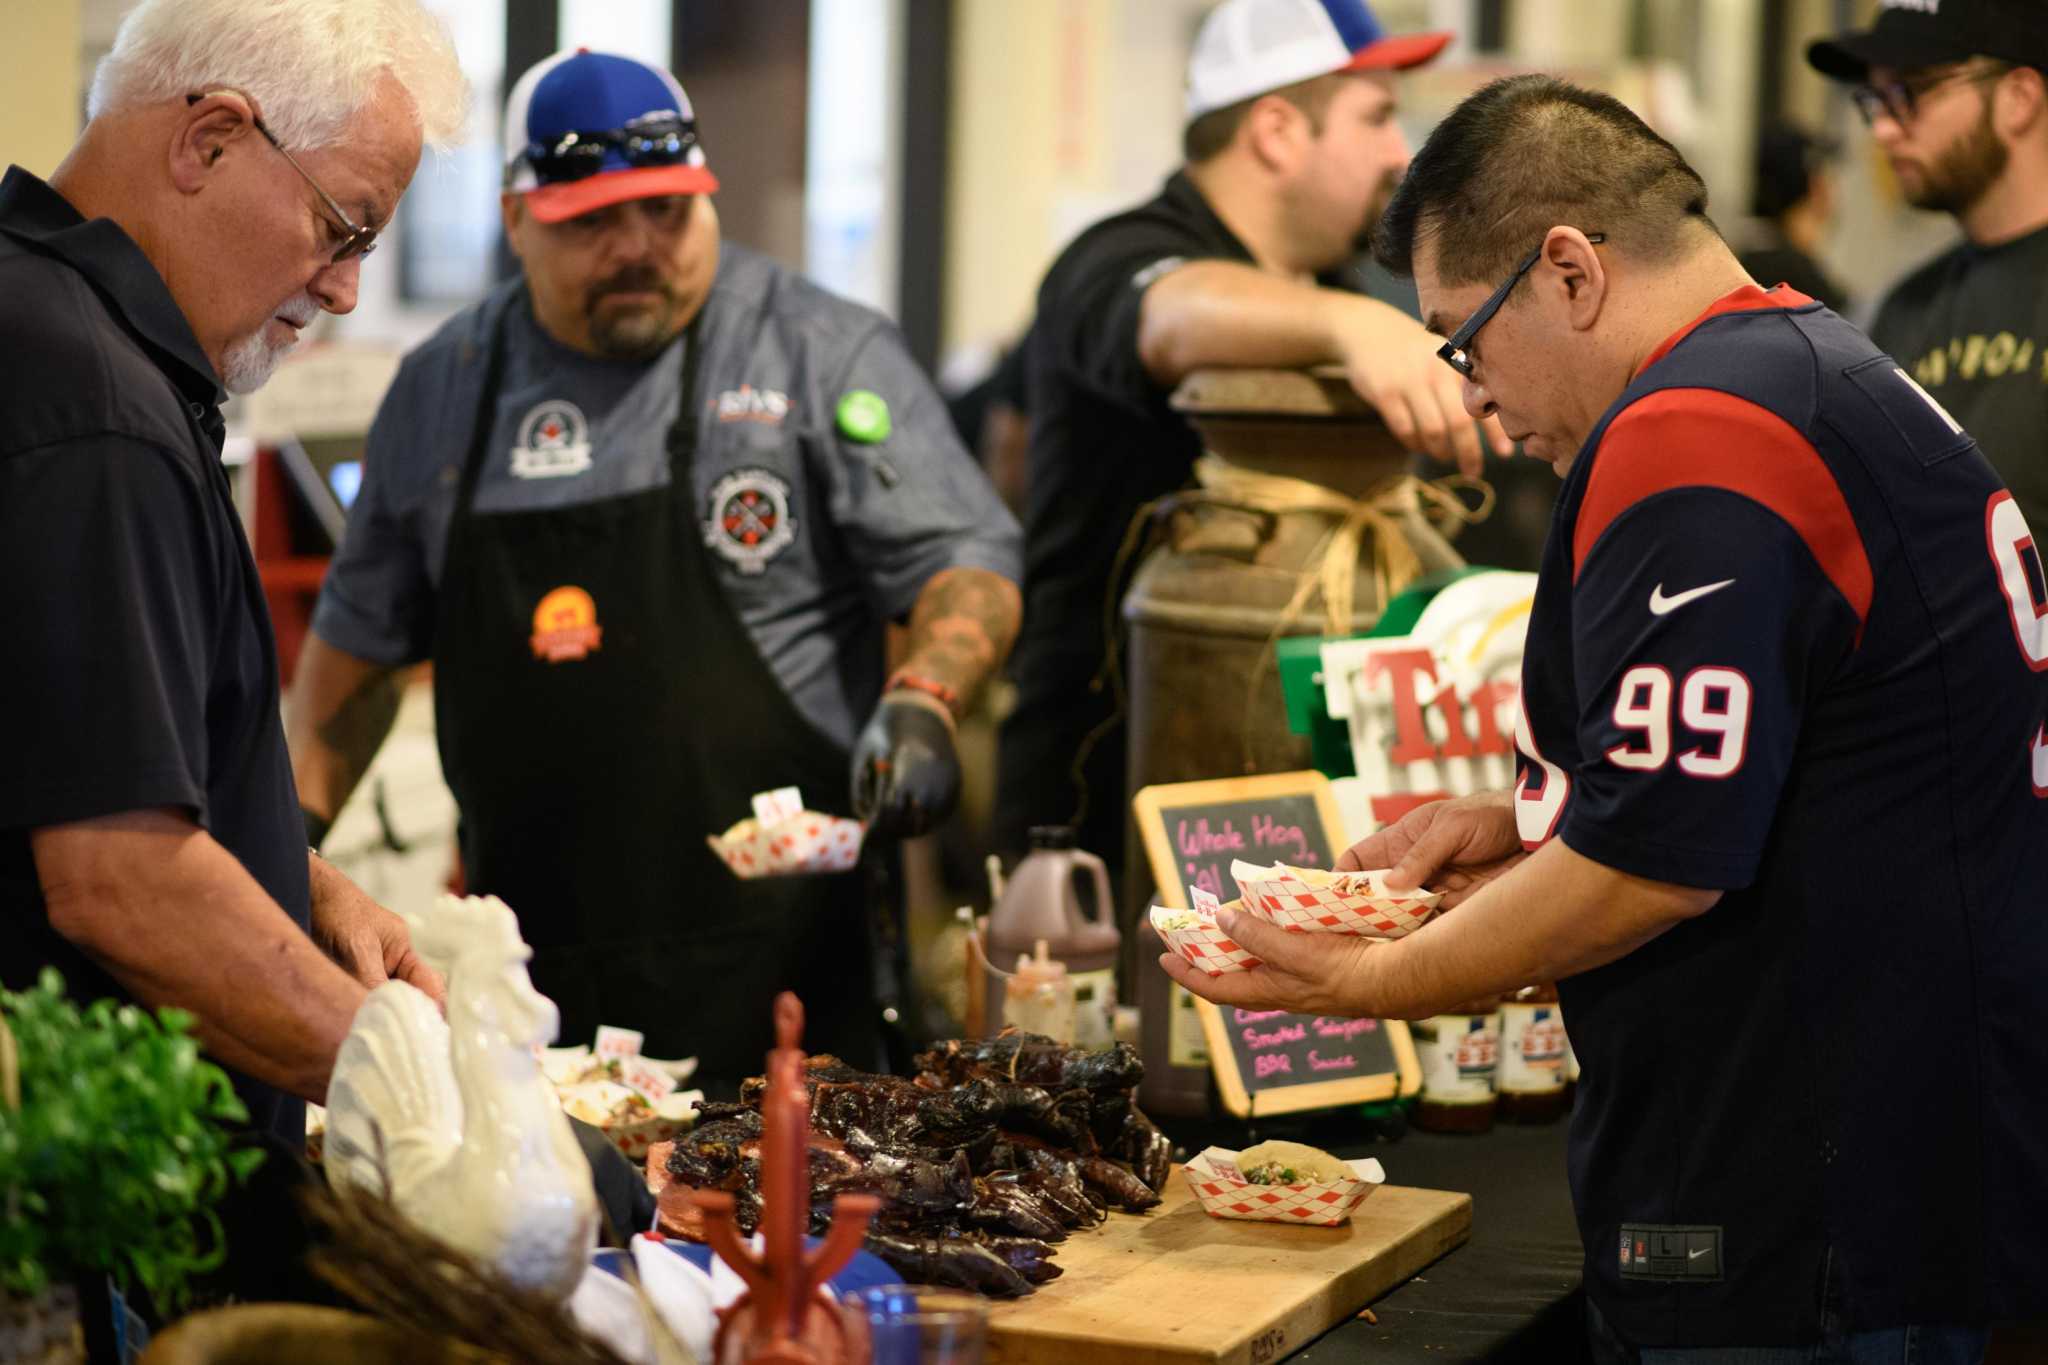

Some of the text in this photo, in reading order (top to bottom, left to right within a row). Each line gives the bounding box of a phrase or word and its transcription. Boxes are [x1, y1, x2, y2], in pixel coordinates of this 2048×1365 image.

[1606, 664, 1752, 780] 99
[1178, 818, 1246, 857] Whole
[1254, 1053, 1293, 1079] BBQ
